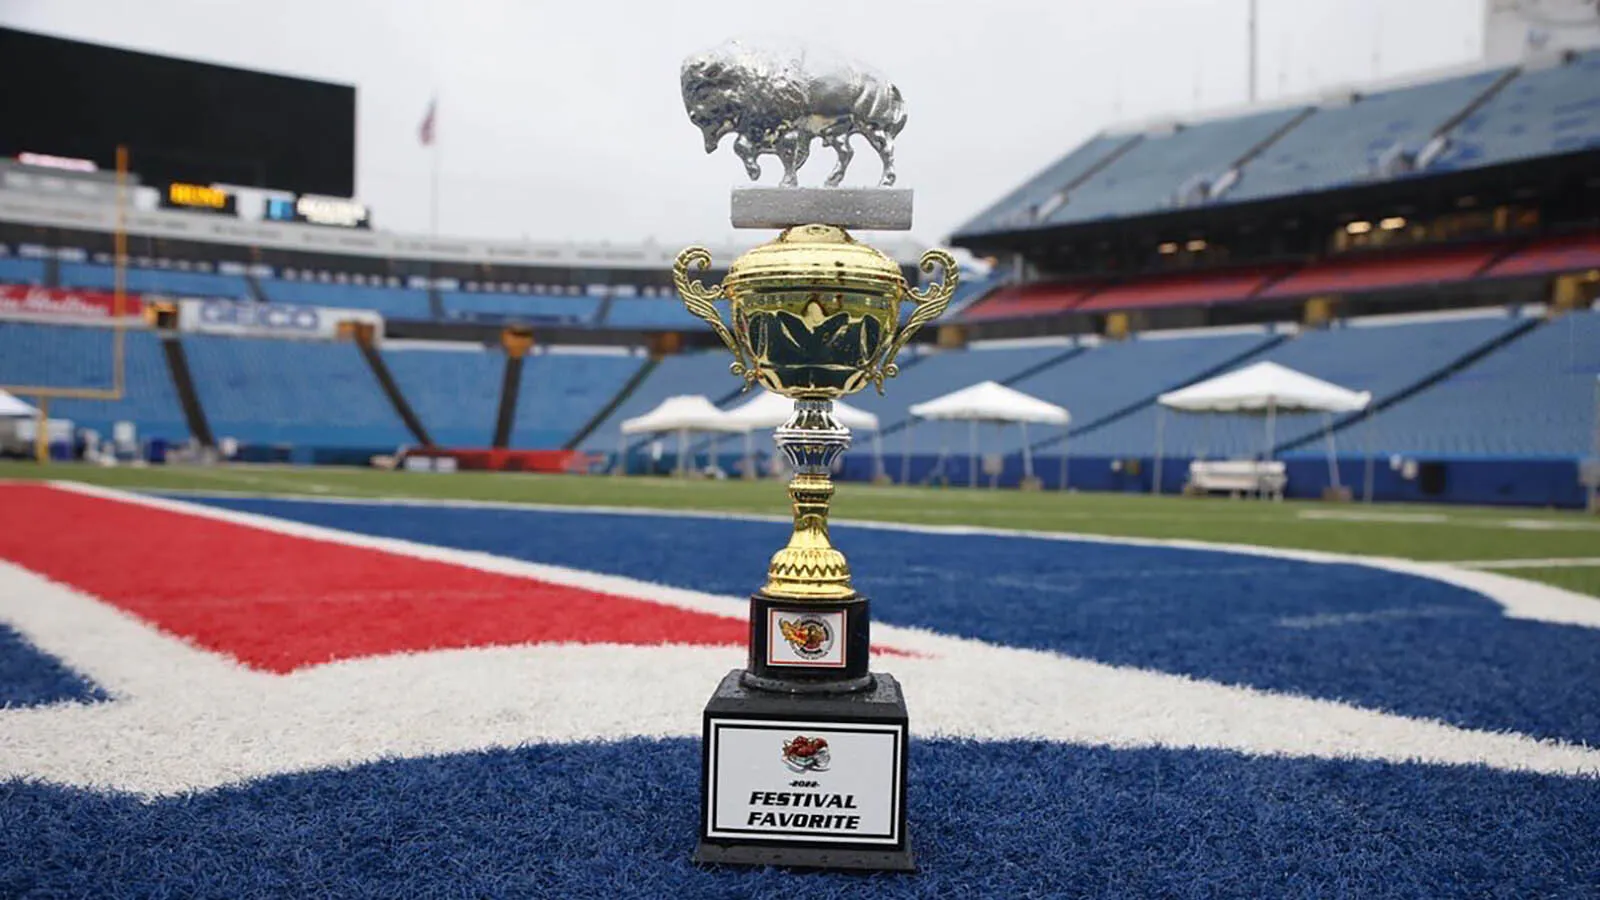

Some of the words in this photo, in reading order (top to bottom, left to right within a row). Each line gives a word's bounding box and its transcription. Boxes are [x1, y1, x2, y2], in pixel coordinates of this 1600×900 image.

[200, 299, 320, 331] GEICO
[749, 791, 857, 809] FESTIVAL
[747, 811, 860, 829] FAVORITE
